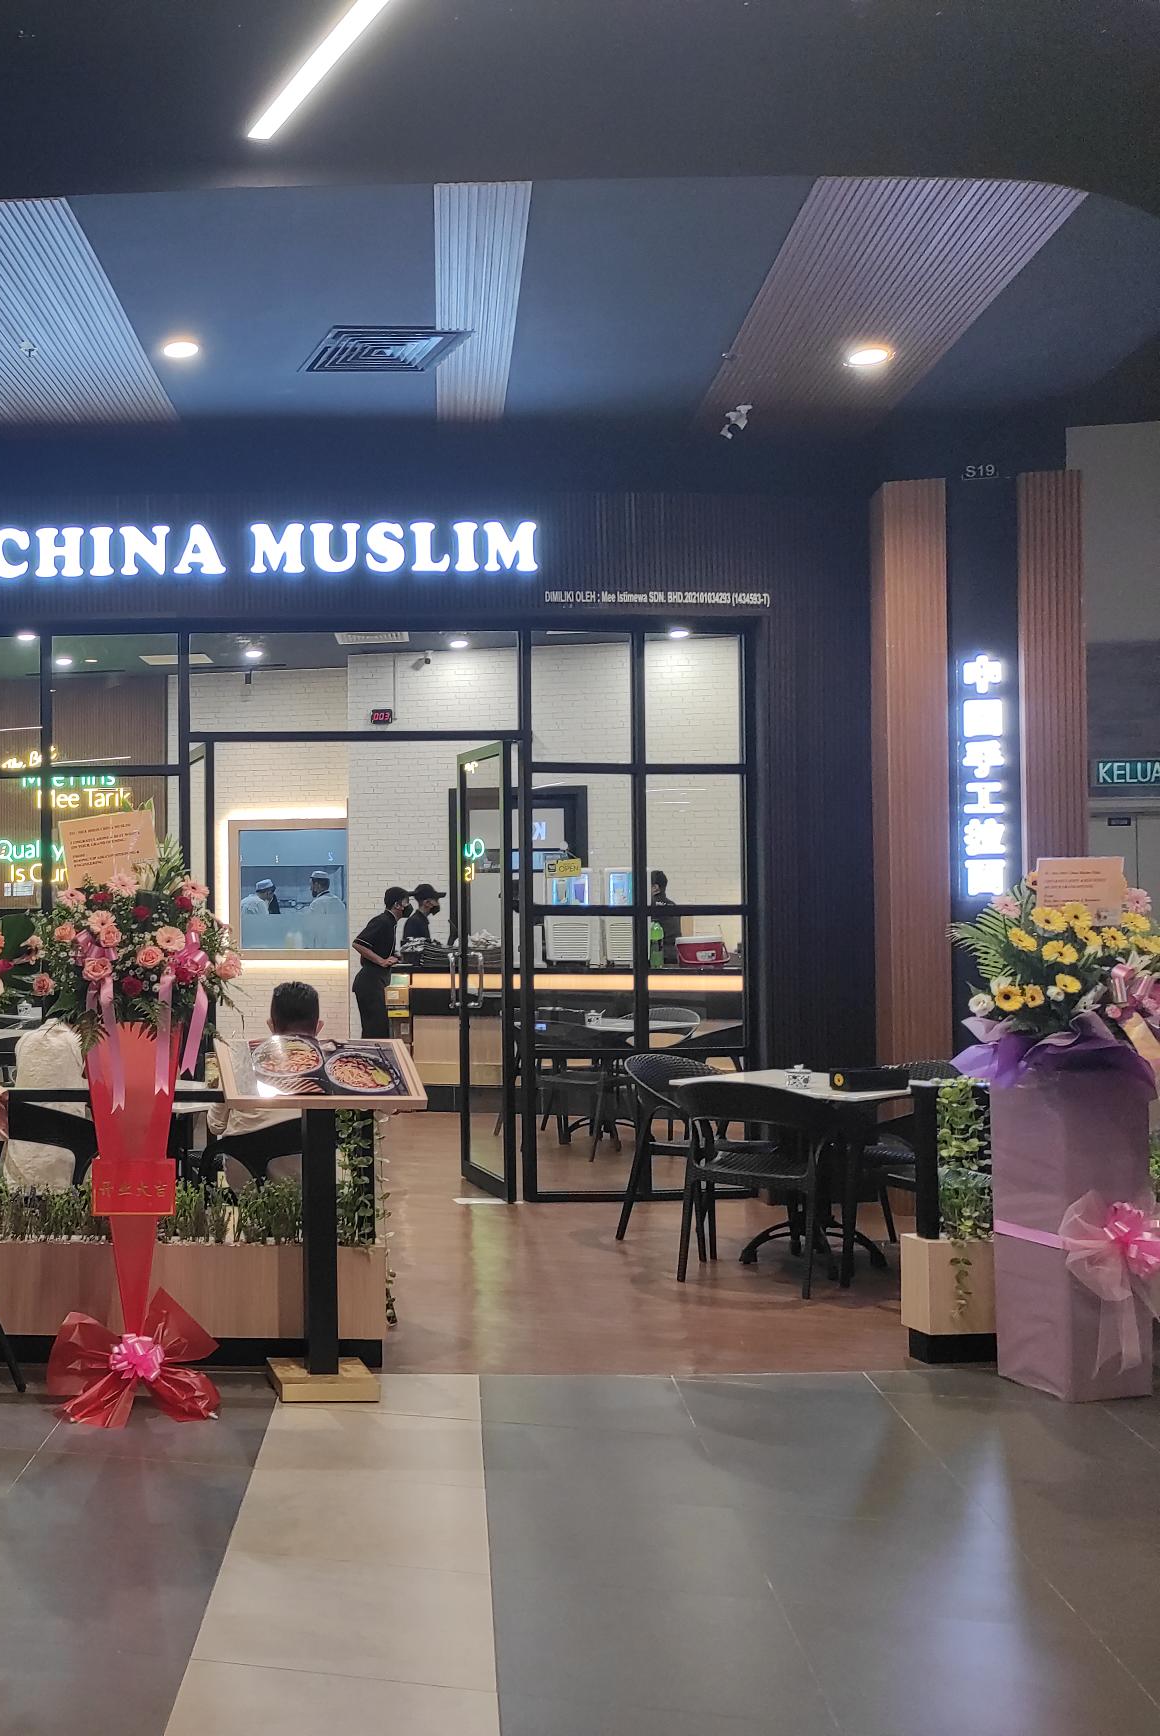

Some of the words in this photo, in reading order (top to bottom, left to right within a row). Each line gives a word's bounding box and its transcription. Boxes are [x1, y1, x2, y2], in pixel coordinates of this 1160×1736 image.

[965, 464, 995, 478] S19
[249, 520, 539, 574] MUSLIM
[544, 591, 574, 603] DIMILIKI
[575, 591, 596, 603] OLEH
[601, 591, 616, 603] Mee
[617, 591, 648, 603] Istimewa
[648, 591, 666, 603] SDN.
[373, 711, 390, 721] 003
[10, 863, 26, 882] Is
[558, 864, 579, 873] OPEN
